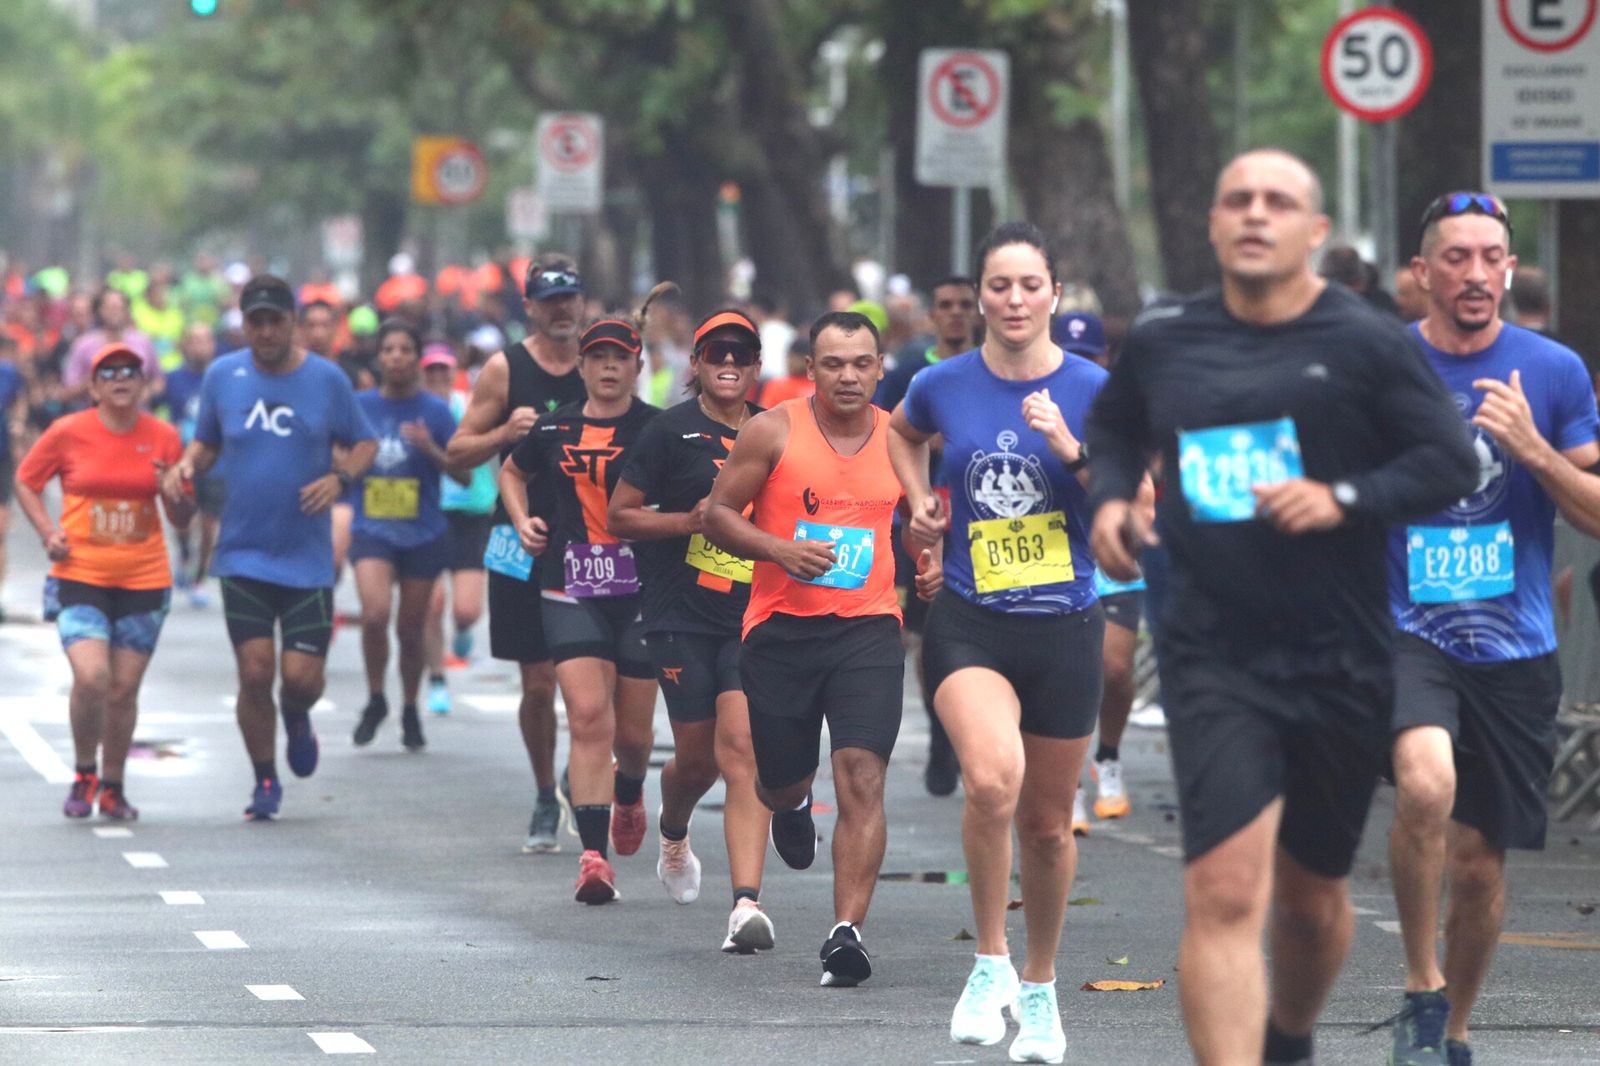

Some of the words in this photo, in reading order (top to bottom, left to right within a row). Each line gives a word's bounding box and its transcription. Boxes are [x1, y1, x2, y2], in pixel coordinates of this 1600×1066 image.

[1343, 33, 1410, 79] 50
[245, 398, 294, 437] AC
[830, 543, 863, 570] 67
[987, 534, 1045, 567] B563
[1425, 542, 1500, 579] E2288
